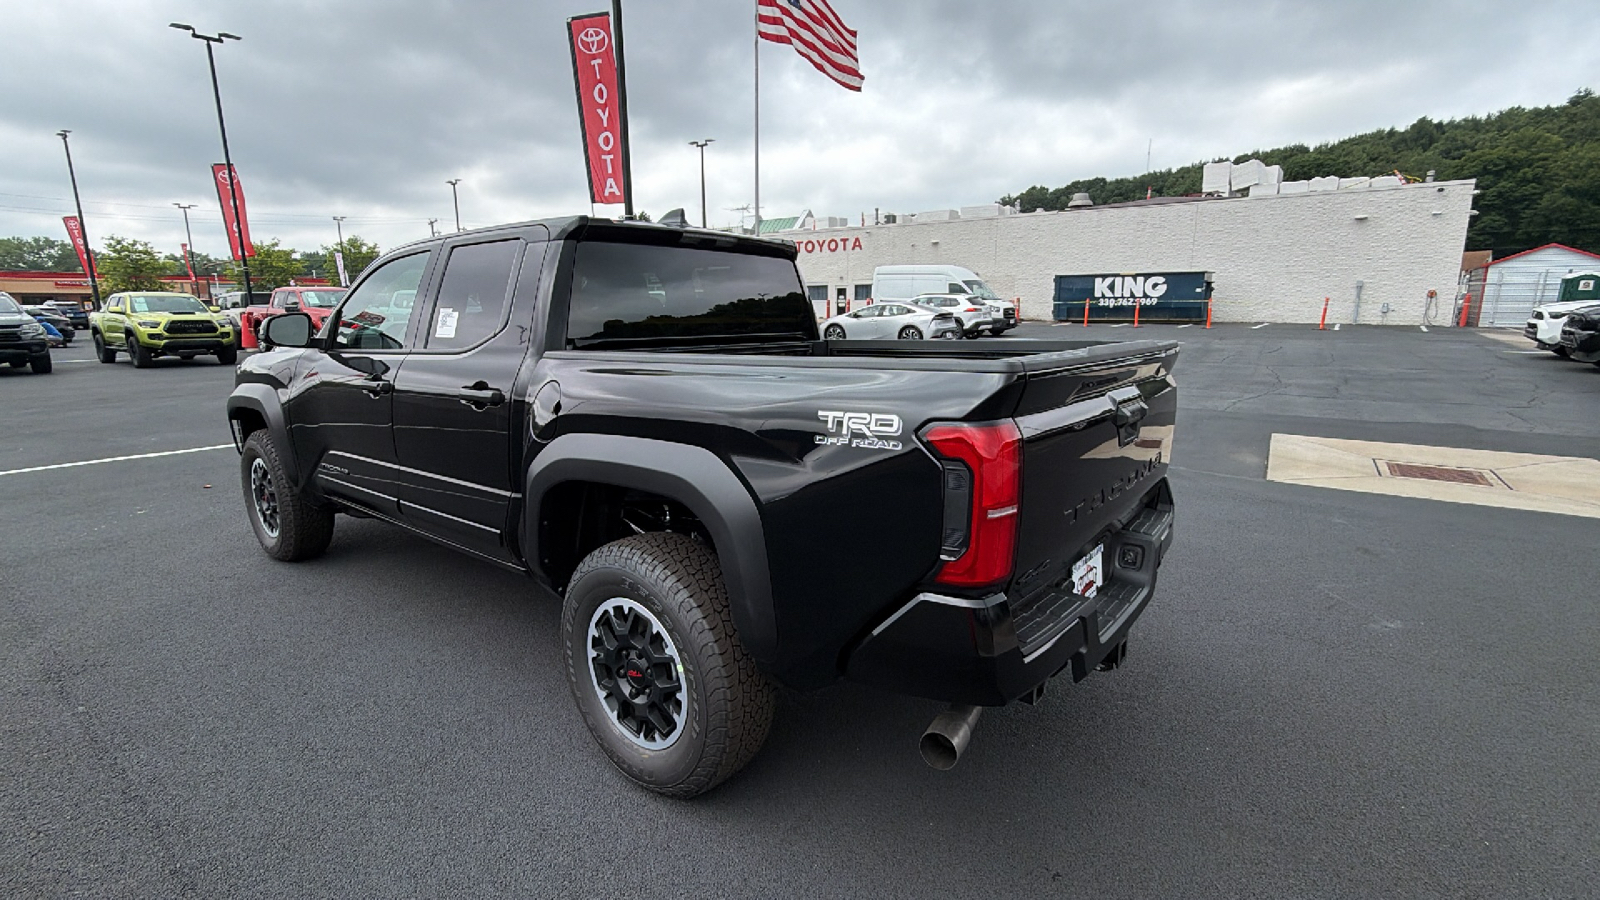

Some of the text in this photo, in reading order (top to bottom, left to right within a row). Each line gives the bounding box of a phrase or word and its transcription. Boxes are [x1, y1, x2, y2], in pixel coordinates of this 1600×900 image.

[591, 59, 621, 197] TOYOTA
[795, 237, 863, 253] TOYOTA
[1094, 276, 1167, 298] KING
[1098, 297, 1158, 307] 330.762.969
[817, 410, 903, 440] TRD
[814, 435, 903, 451] OFF ROAD
[1063, 451, 1163, 526] TACOMA
